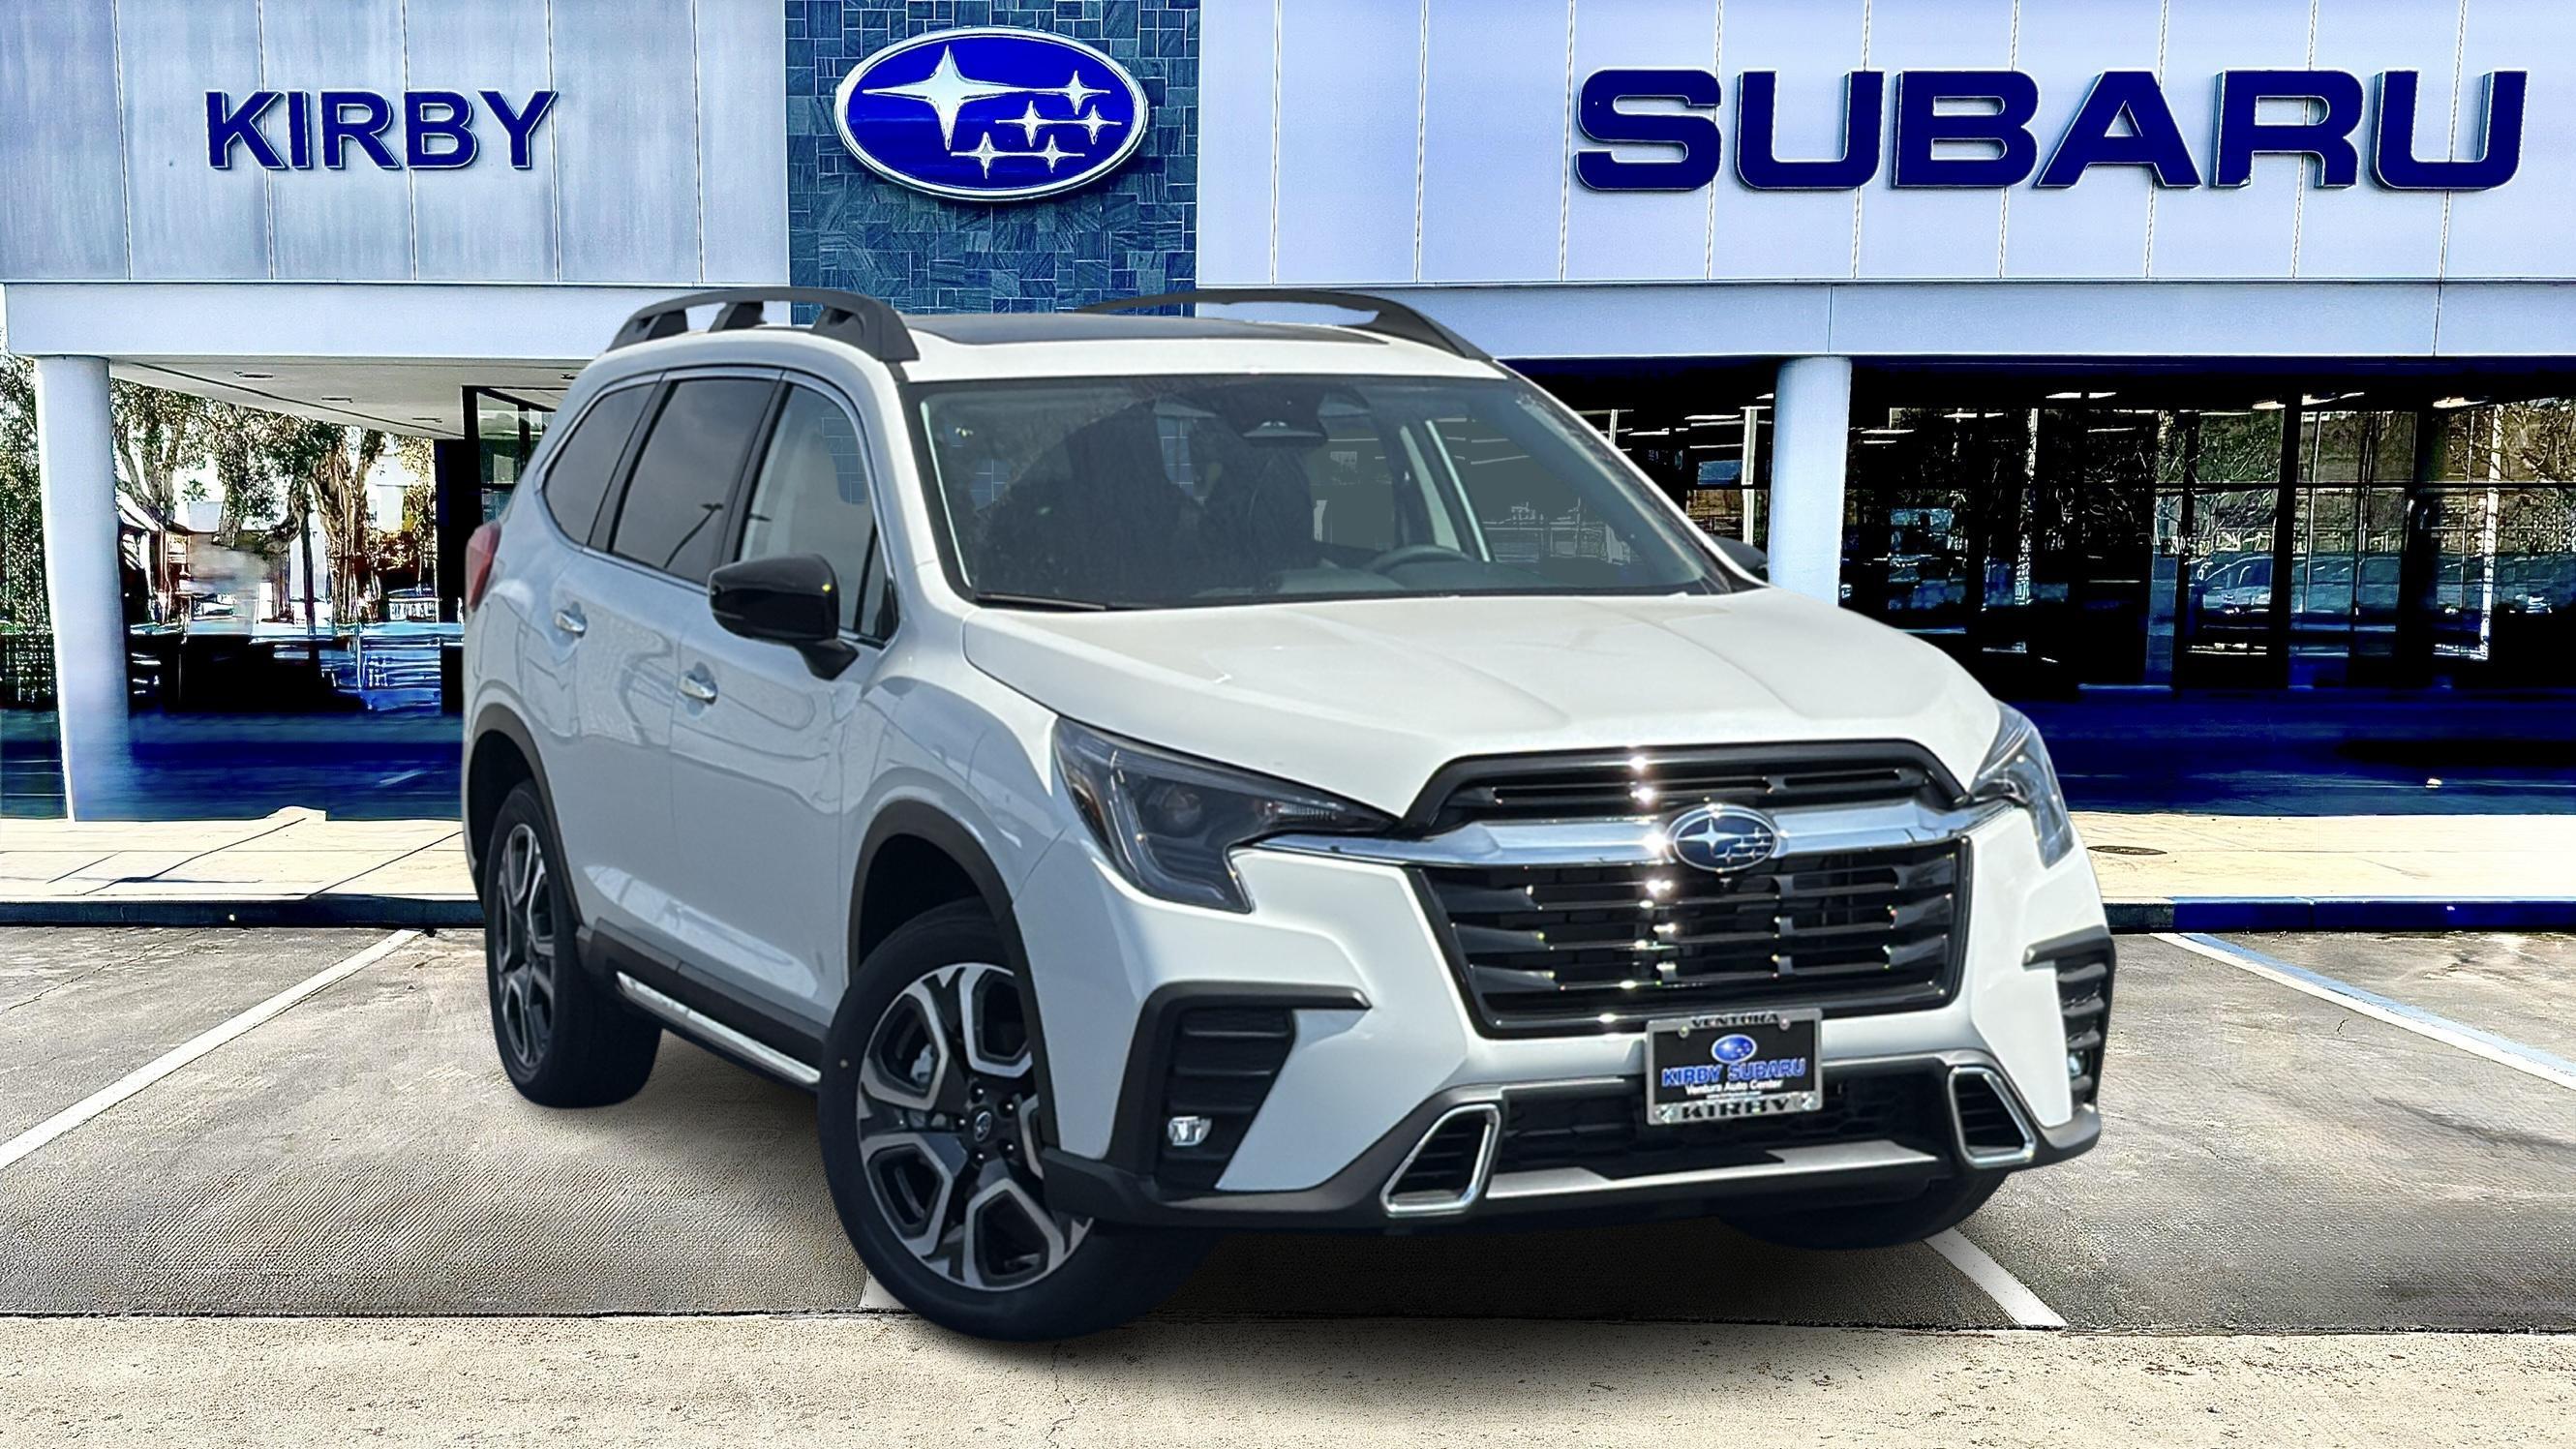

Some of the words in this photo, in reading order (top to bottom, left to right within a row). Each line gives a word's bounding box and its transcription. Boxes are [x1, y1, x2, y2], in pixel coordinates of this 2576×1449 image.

[204, 89, 559, 169] KIRBY
[1575, 68, 2528, 191] SUBARU
[1691, 1012, 1779, 1028] VENTURA
[1661, 1064, 1723, 1087] KIRBY
[1727, 1058, 1805, 1081] SUBARU
[1685, 1083, 1722, 1096] Ventura
[1723, 1081, 1747, 1092] Auto
[1749, 1079, 1783, 1091] Center
[1682, 1099, 1789, 1119] KIRBY
